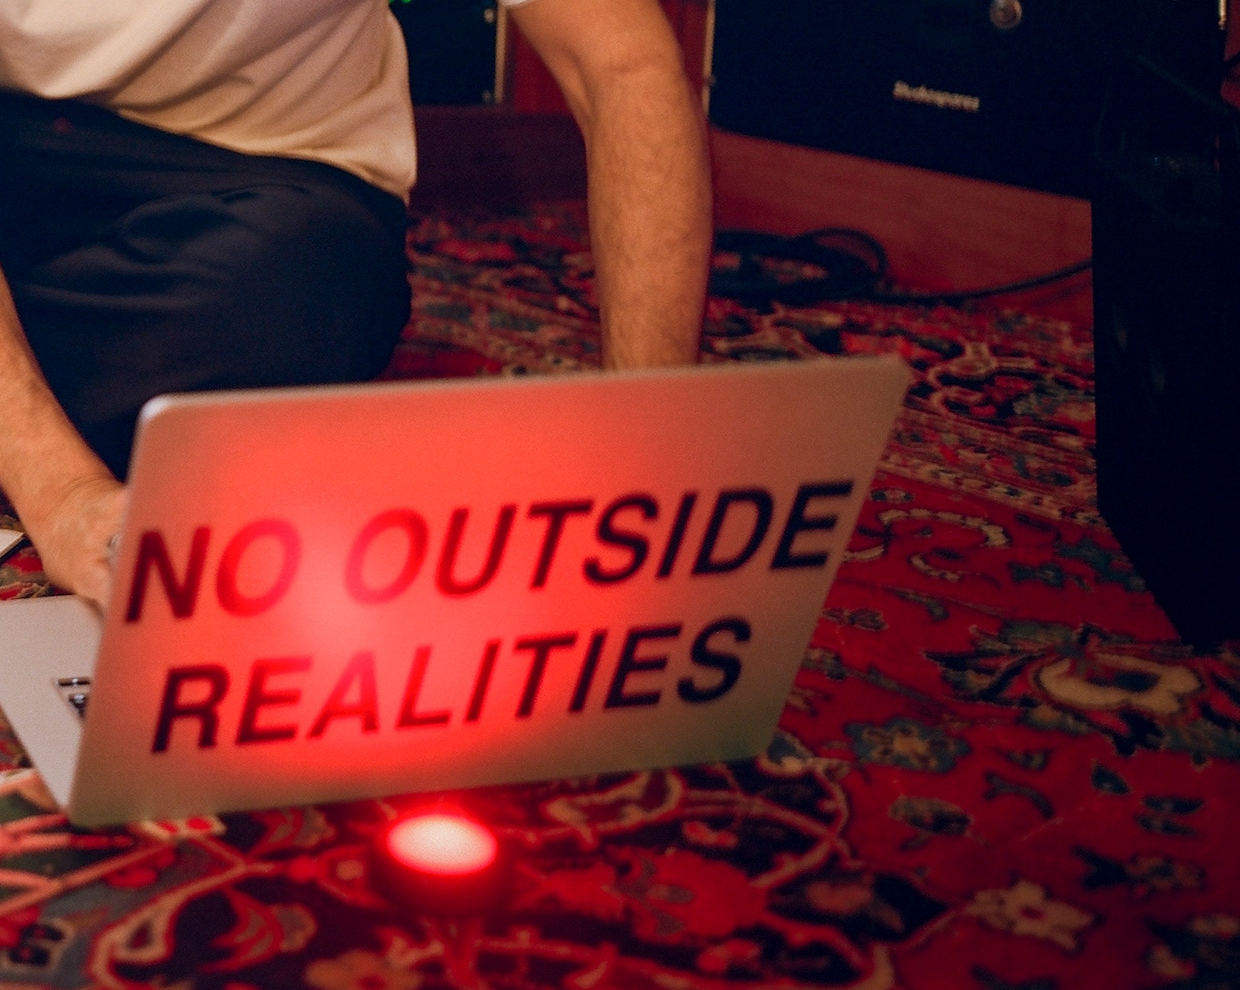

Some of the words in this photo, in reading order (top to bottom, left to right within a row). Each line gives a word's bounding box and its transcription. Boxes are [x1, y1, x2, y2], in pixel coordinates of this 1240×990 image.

[124, 517, 302, 623] NO
[344, 479, 855, 605] OUTSIDE
[150, 617, 752, 754] REALITIES
